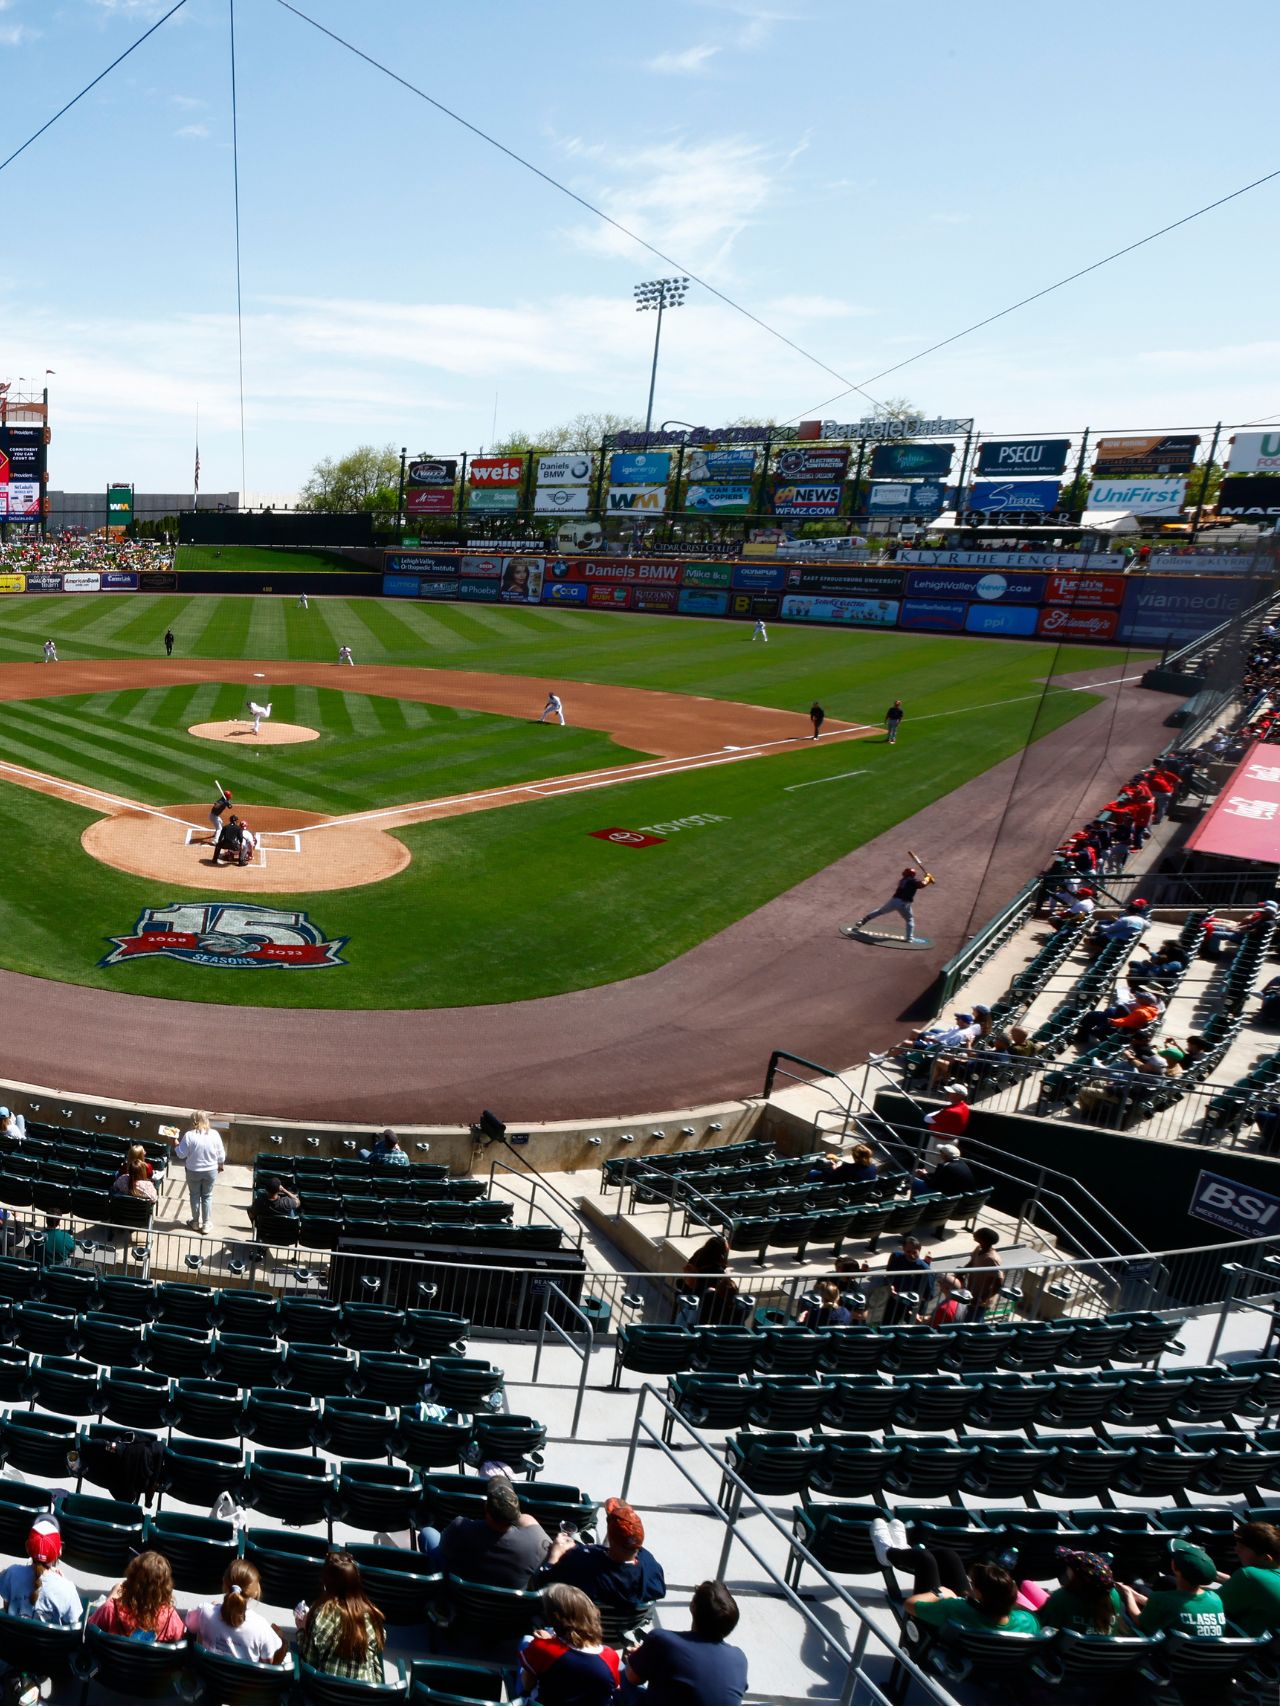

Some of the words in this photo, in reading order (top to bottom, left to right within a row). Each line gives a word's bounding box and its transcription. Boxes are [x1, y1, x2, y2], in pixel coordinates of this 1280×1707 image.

[820, 416, 956, 439] PenTeleData
[998, 445, 1045, 463] PSECU
[472, 463, 520, 480] weis
[540, 462, 569, 471] Daniels
[543, 470, 565, 478] BMW
[610, 494, 660, 508] WM
[774, 486, 796, 503] 69
[796, 489, 839, 502] NEWS
[1093, 488, 1180, 503] UniFirst
[775, 507, 835, 515] WFMZ.COM
[997, 512, 1071, 525] KLYR
[654, 543, 680, 551] CEDAR
[680, 543, 705, 552] CREST
[706, 543, 740, 553] COLLEGE
[401, 557, 419, 565] Lehigh
[420, 558, 436, 566] Valley
[900, 551, 959, 565] KLYR
[967, 554, 996, 564] THE
[1007, 554, 1065, 566] FENCE
[1156, 557, 1192, 566] Follow
[401, 564, 431, 572] Orthopedic
[585, 563, 636, 577] Daniels
[639, 565, 678, 579] BMW
[741, 568, 778, 576] OLYMPUS
[686, 570, 710, 579] Mike
[713, 571, 728, 580] Ike
[469, 586, 497, 595] Phoebe
[735, 597, 749, 612] B
[1136, 591, 1240, 609] viamedia
[984, 617, 1004, 628] ppl
[1044, 610, 1110, 630] Friendly's
[637, 813, 733, 835] TOYOTA
[149, 906, 312, 946] 15
[266, 948, 303, 956] 2023
[192, 953, 258, 965] SEASONS
[1200, 1182, 1279, 1225] BSI
[1195, 1206, 1233, 1226] MEETING
[1234, 1222, 1251, 1233] ALL
[1180, 1612, 1217, 1625] CLASS
[1197, 1625, 1222, 1637] 2030
